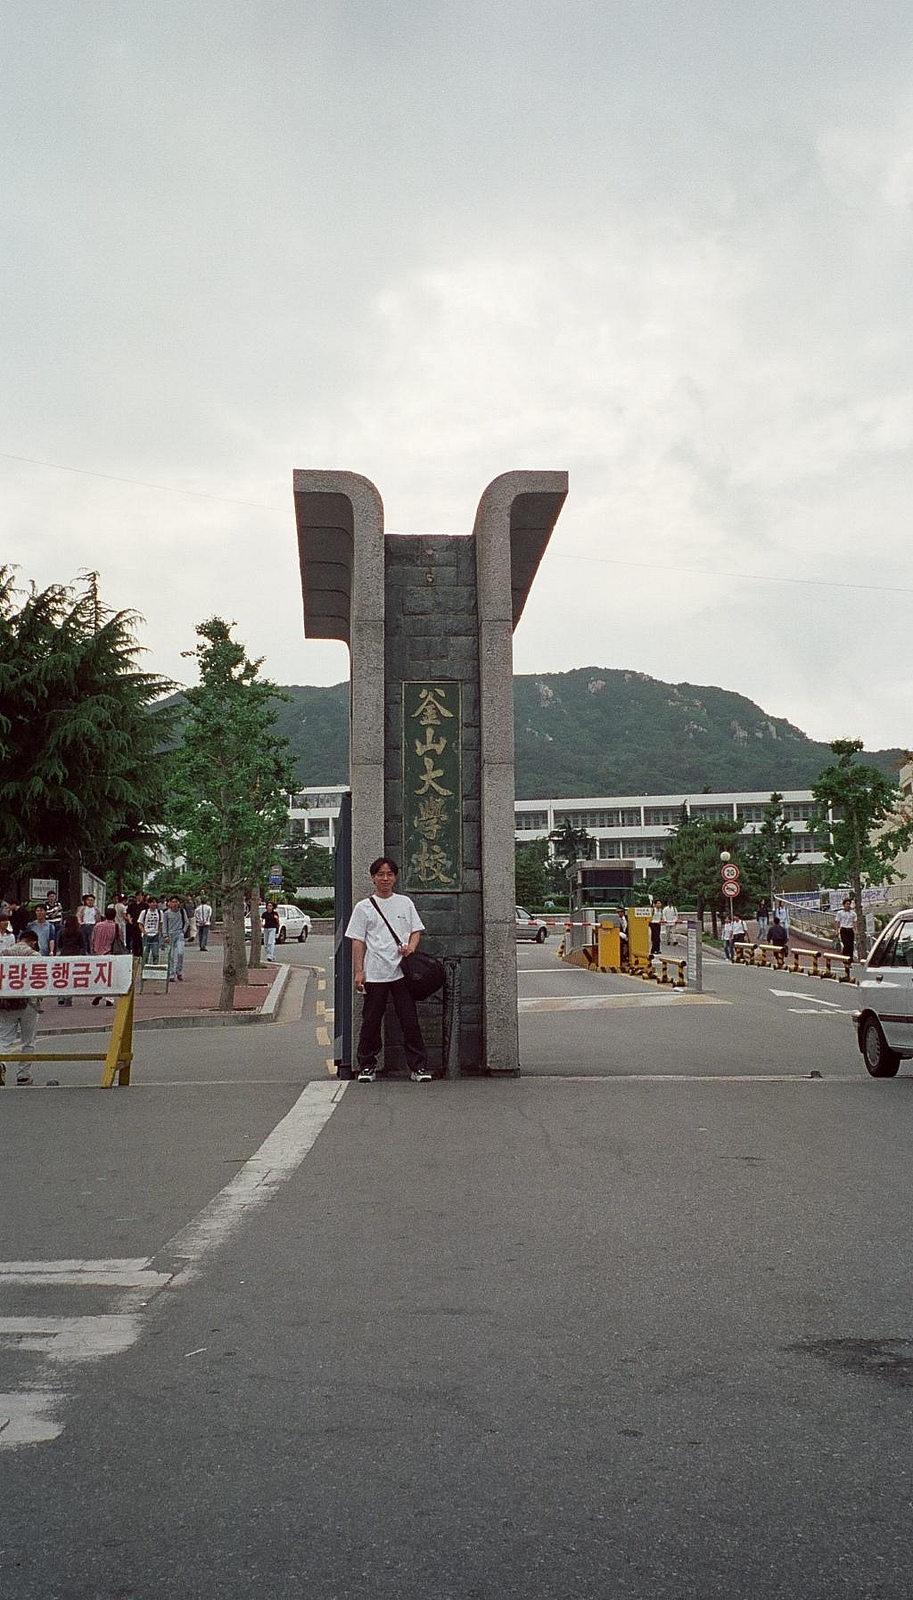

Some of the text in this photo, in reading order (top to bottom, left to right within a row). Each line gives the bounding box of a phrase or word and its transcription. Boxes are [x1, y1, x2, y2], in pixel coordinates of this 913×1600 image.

[410, 688, 454, 885] 釜山大學校
